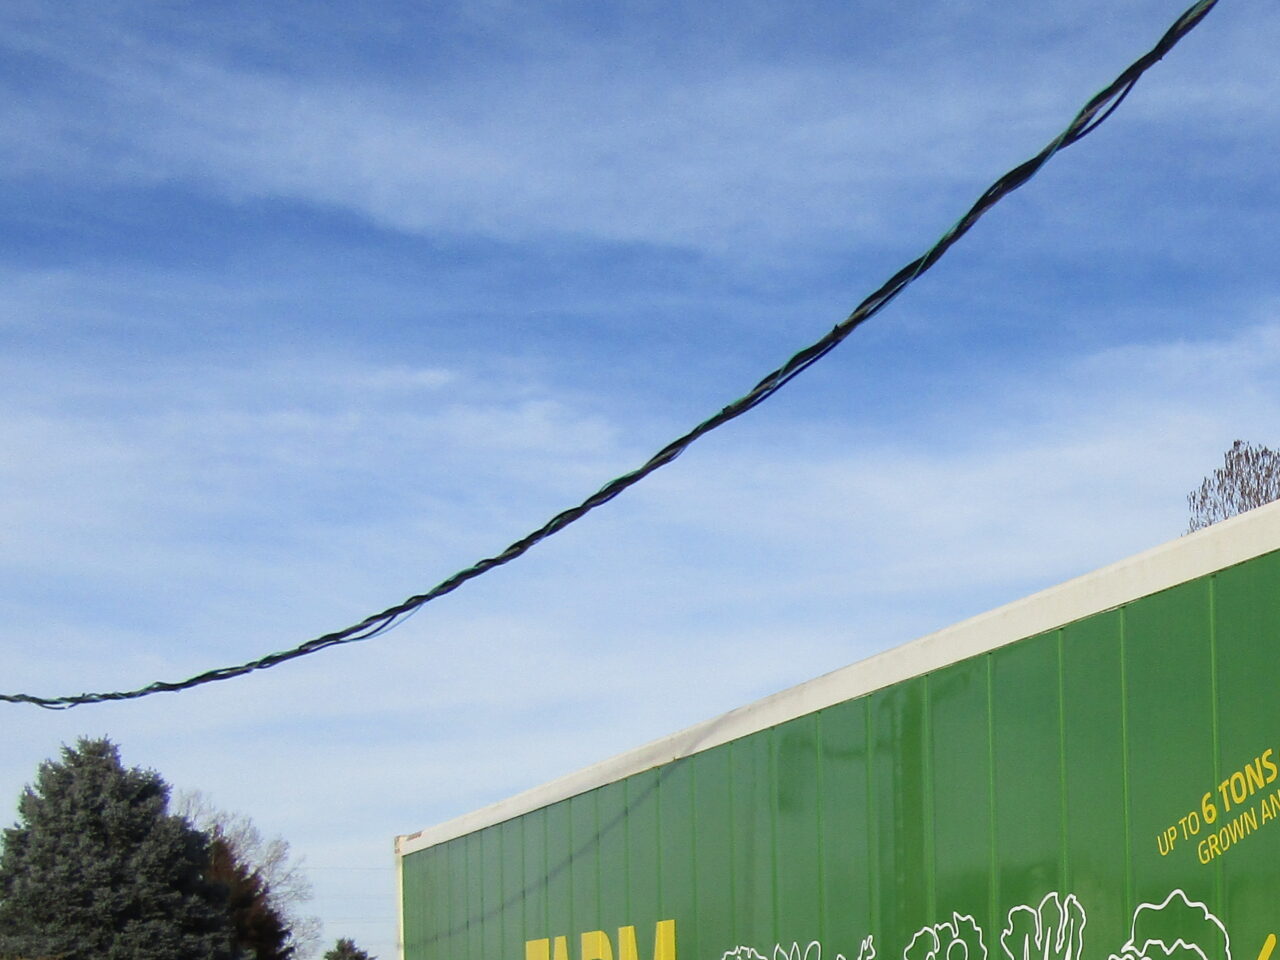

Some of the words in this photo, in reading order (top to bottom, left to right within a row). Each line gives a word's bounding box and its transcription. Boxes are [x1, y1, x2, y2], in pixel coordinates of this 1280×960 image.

[1156, 825, 1178, 856] UP
[1178, 811, 1201, 841] TO
[1201, 792, 1217, 825] 6
[1218, 748, 1278, 812] TONS
[1197, 807, 1258, 865] GROWN
